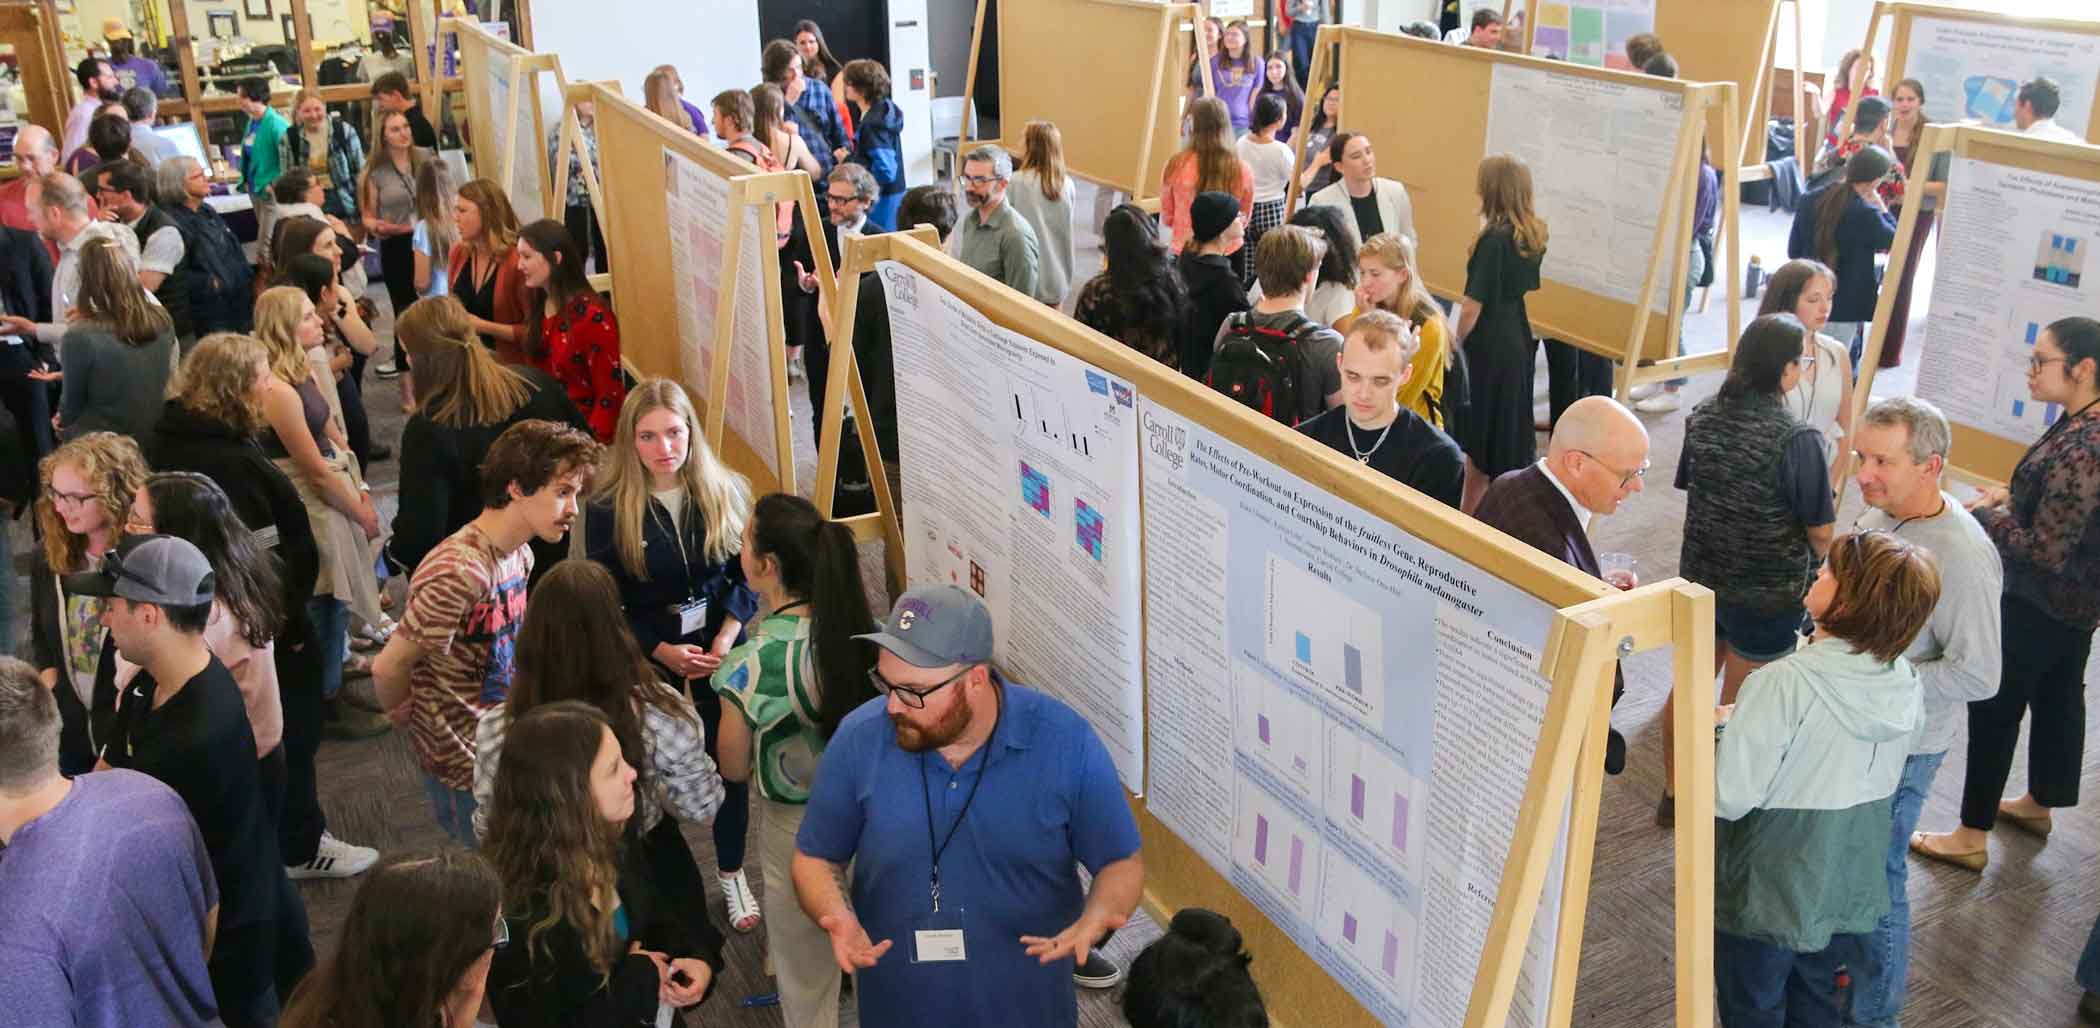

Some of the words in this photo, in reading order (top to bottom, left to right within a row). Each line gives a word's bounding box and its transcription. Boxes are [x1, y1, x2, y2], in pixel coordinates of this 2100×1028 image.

[1144, 411, 1173, 441] Carroll
[1150, 433, 1184, 470] College
[1190, 451, 1208, 470] Rates,
[1210, 461, 1229, 480] Motor
[1229, 473, 1275, 506] Coordination,
[1276, 499, 1290, 514] and
[1291, 505, 1328, 536] Courtship
[1329, 527, 1367, 557] Behaviors
[1369, 549, 1378, 561] in
[1380, 554, 1423, 588] Drosophila
[1424, 579, 1485, 618] melanogaster
[1196, 439, 1207, 451] The
[1208, 445, 1230, 466] Effects
[1230, 459, 1239, 470] of
[1239, 462, 1281, 494] Pre-Workout
[1282, 487, 1292, 498] on
[1293, 492, 1334, 521] Expression
[1335, 513, 1344, 526] of
[1344, 517, 1358, 534] the
[1357, 524, 1391, 550] fruitless
[1393, 542, 1416, 565] Gene,
[1418, 558, 1477, 597] Reproductive
[1308, 562, 1332, 583] Results
[1487, 630, 1532, 660] Conclusion
